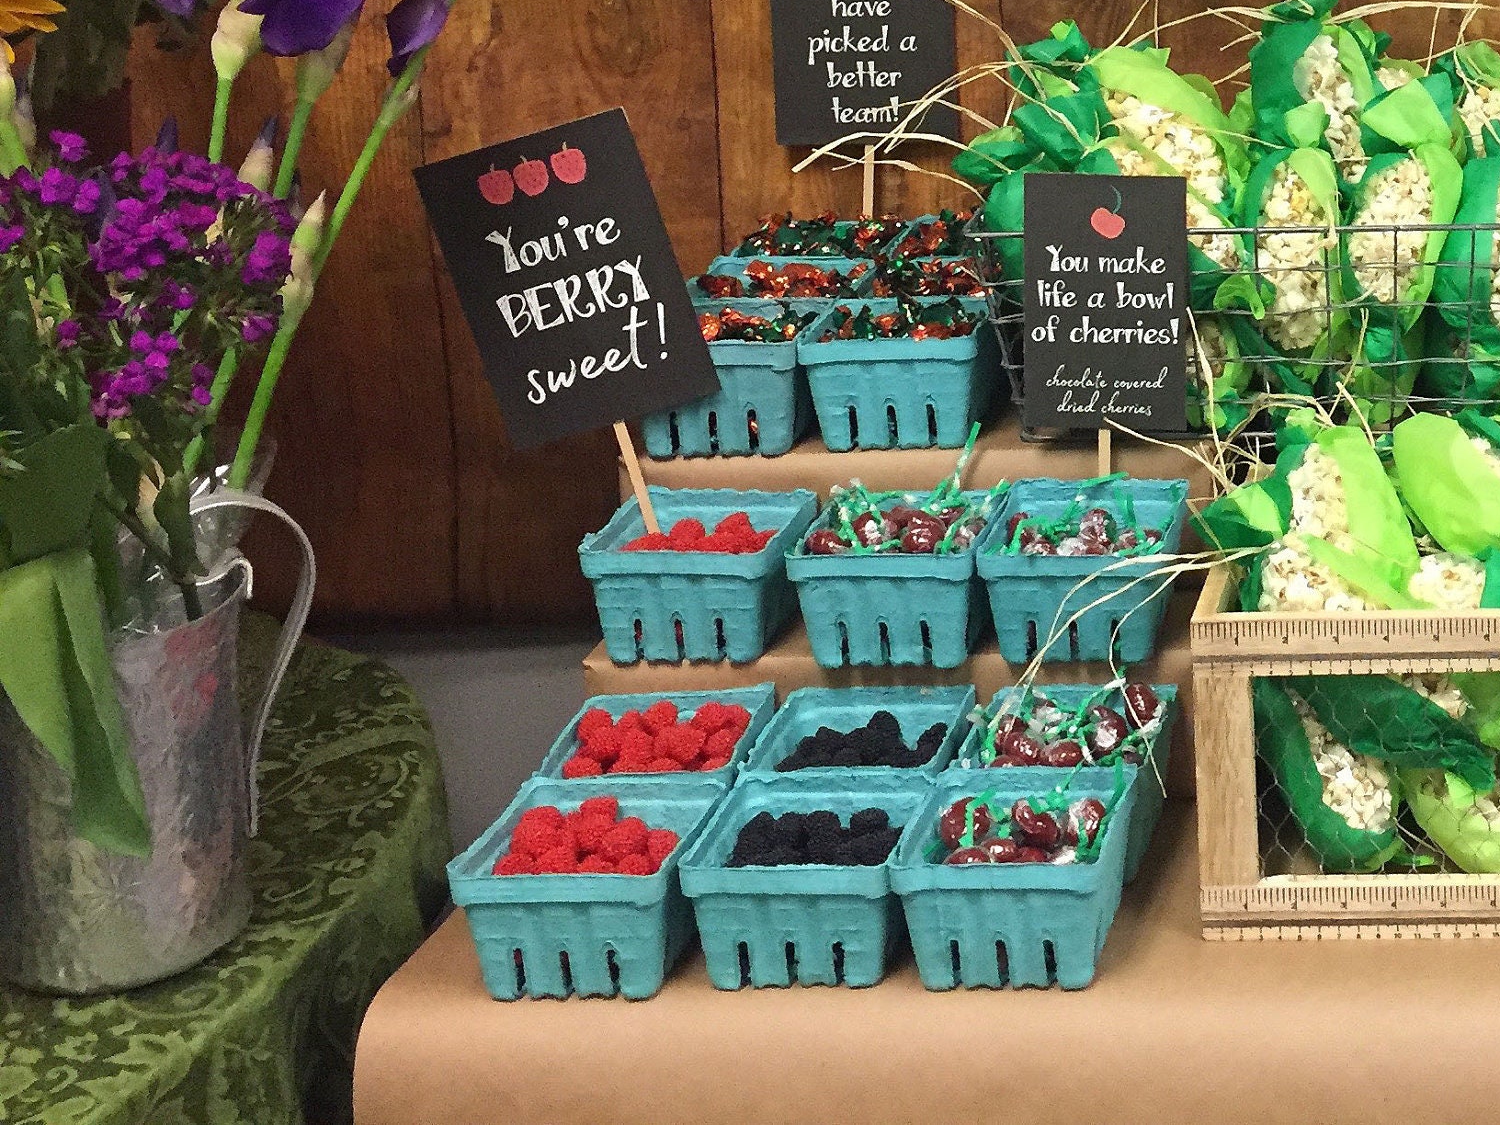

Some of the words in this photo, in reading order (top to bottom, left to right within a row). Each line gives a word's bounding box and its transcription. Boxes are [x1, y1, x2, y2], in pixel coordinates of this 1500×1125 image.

[807, 24, 890, 68] picked
[899, 35, 918, 52] a
[826, 60, 902, 88] better
[830, 95, 900, 124] team!
[484, 215, 623, 276] You're
[1045, 244, 1089, 273] You
[1098, 246, 1166, 274] make
[495, 252, 651, 341] BERRY
[1037, 279, 1078, 308] life
[1087, 292, 1106, 309] a
[1115, 281, 1174, 310] bowl
[1030, 314, 1060, 343] of
[1069, 315, 1180, 345] cherries!
[523, 300, 668, 405] sweet!
[1045, 364, 1108, 393] chocolate
[1113, 366, 1169, 390] covered
[1056, 389, 1100, 414] dried
[1100, 390, 1152, 417] cherries
